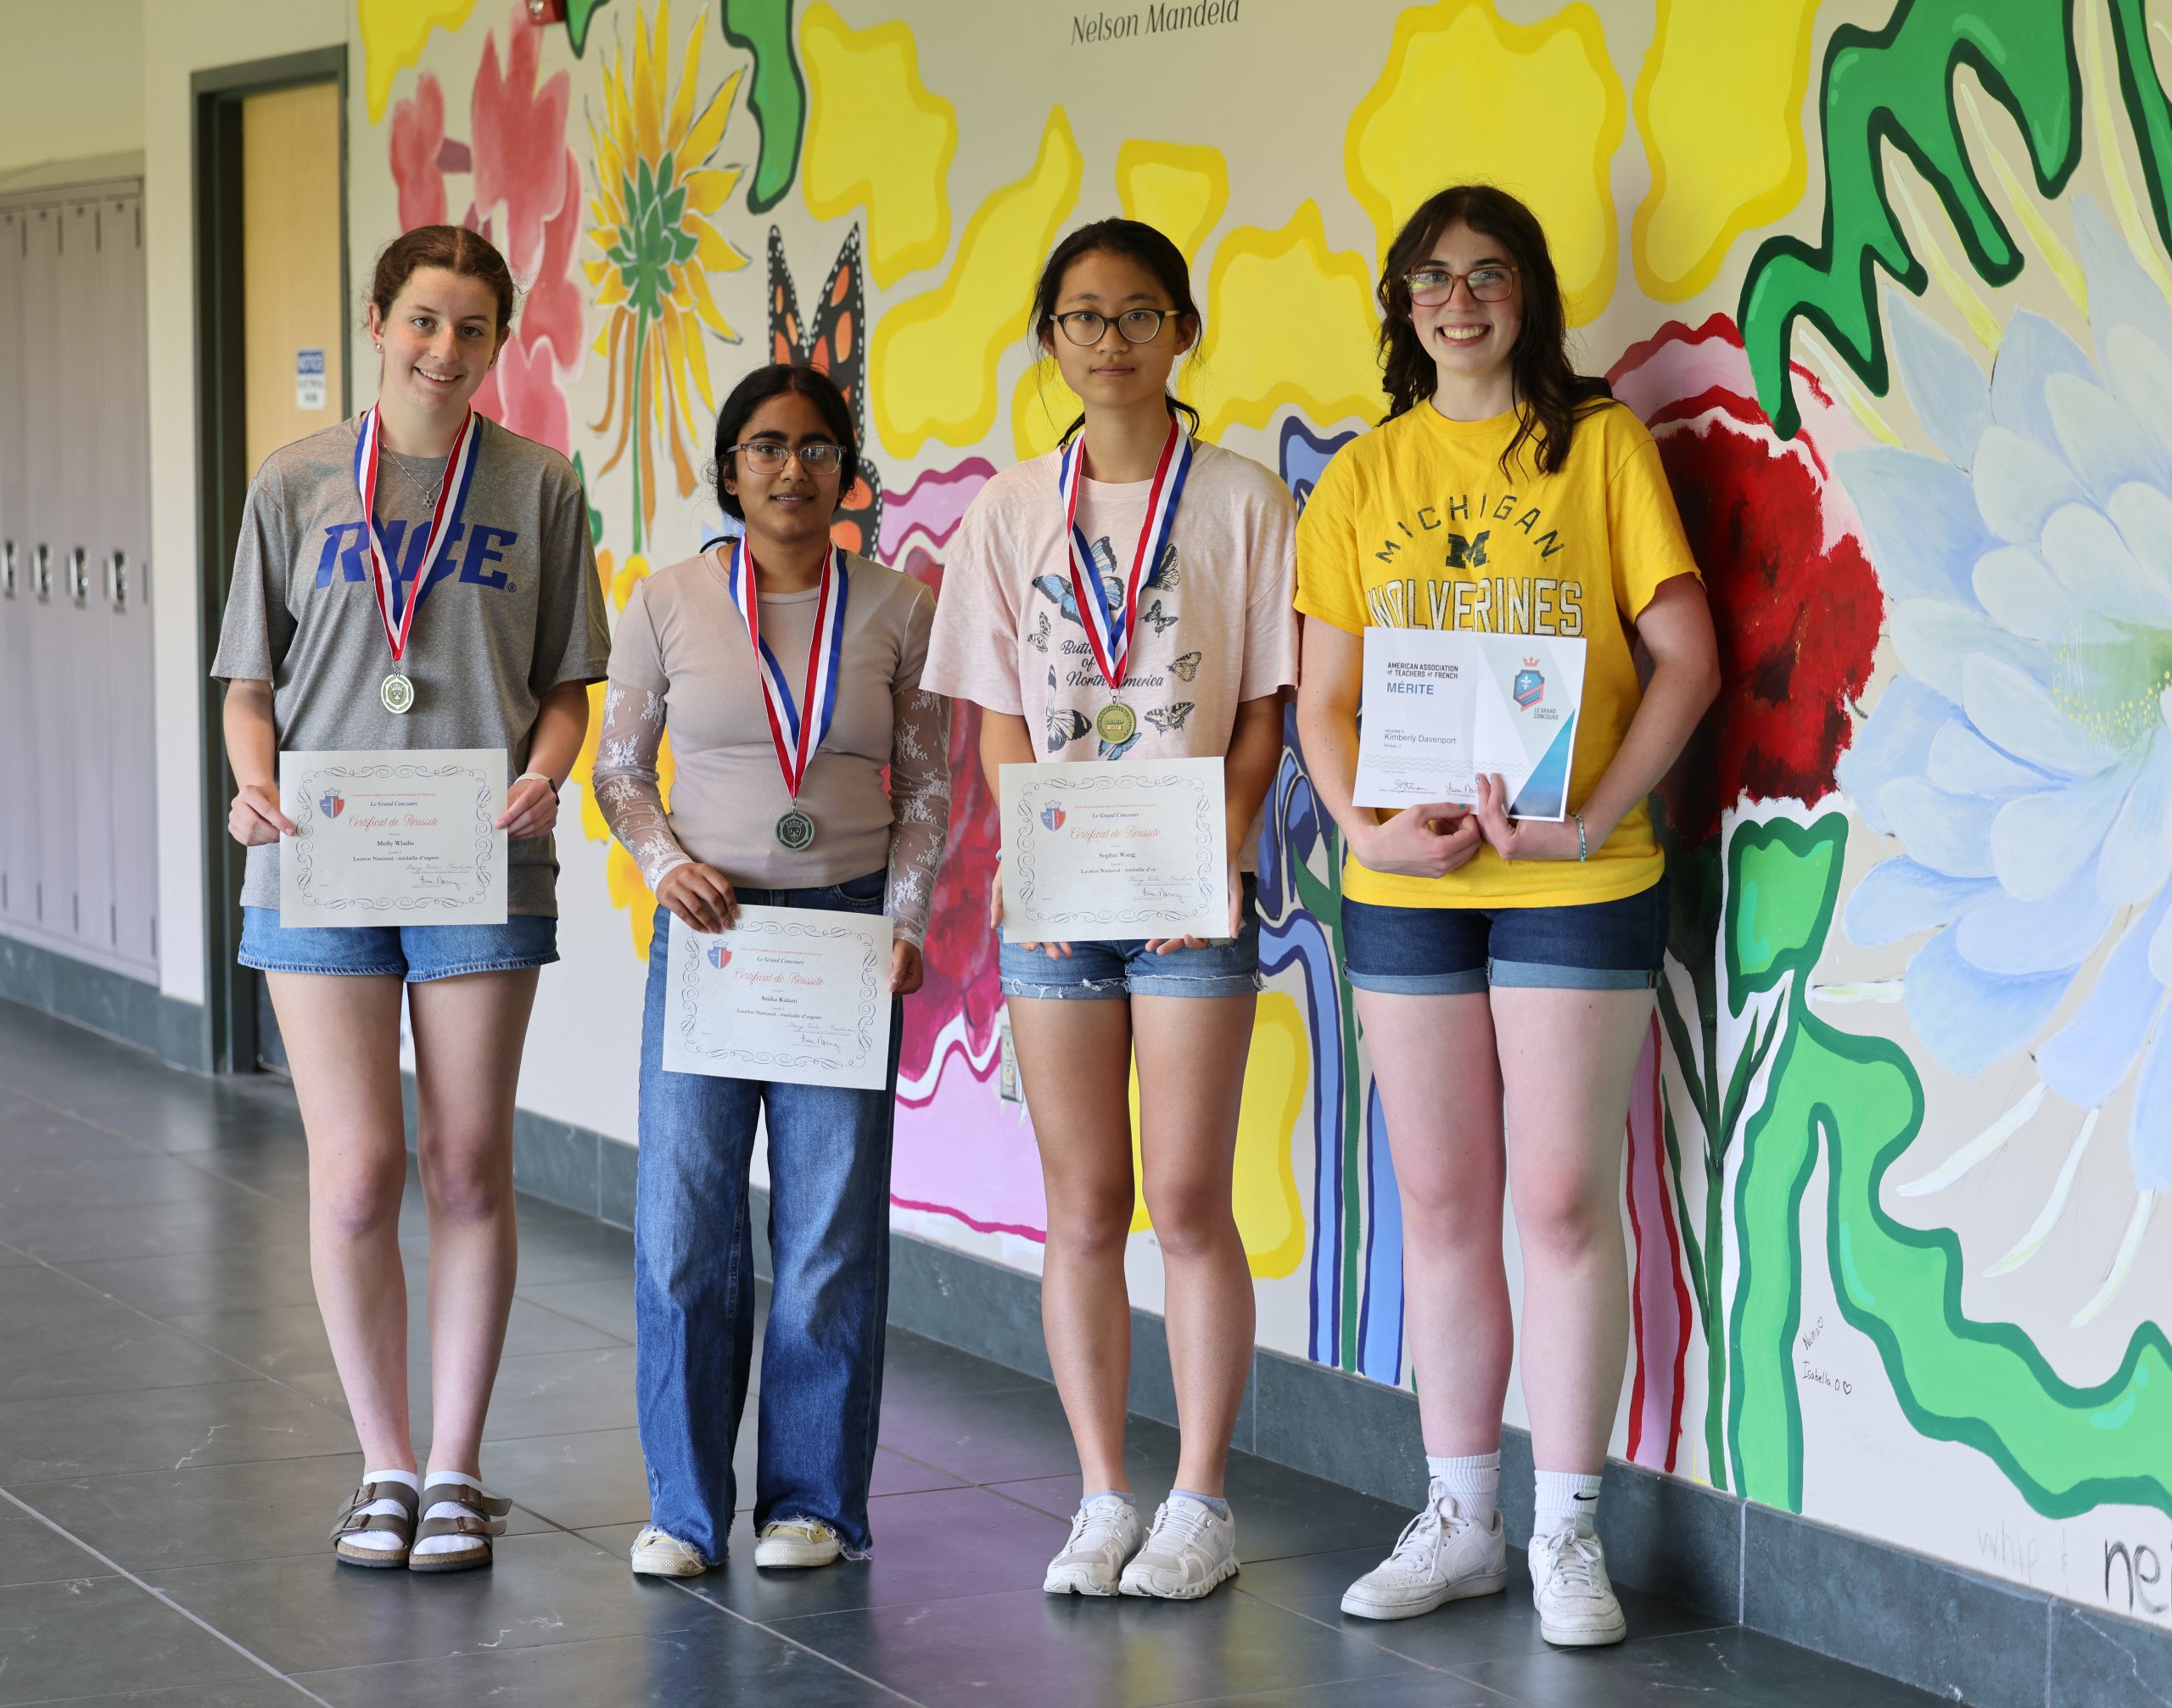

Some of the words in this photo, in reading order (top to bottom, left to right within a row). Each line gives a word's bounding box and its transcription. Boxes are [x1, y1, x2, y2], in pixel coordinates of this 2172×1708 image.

[1071, 12, 1139, 46] Nelson
[1145, 0, 1240, 35] Mandela
[1375, 492, 1565, 563] MICHIGAN
[1368, 577, 1583, 637] WOLVERINES
[1082, 656, 1095, 672] of
[1387, 662, 1419, 670] AMERICAN
[1419, 664, 1458, 672] ASSOCIATION
[1066, 671, 1106, 686] North
[1395, 669, 1425, 678] TEACHERS
[1434, 671, 1458, 680] FRENCH
[1386, 680, 1434, 695] MÉRITE
[1384, 732, 1417, 743] Kimberly
[1418, 734, 1457, 746] Davenport
[349, 814, 388, 832] Certificat
[389, 816, 400, 827] de
[401, 814, 439, 827] Réussite
[1070, 826, 1110, 843] Certificat
[1111, 827, 1121, 838] de
[1124, 825, 1161, 838] Réussite
[734, 967, 774, 985] Certificat
[774, 973, 785, 983] de
[787, 972, 825, 986] Réussite
[1802, 1361, 1831, 1387] Isabella
[2104, 1539, 2172, 1615] ne
